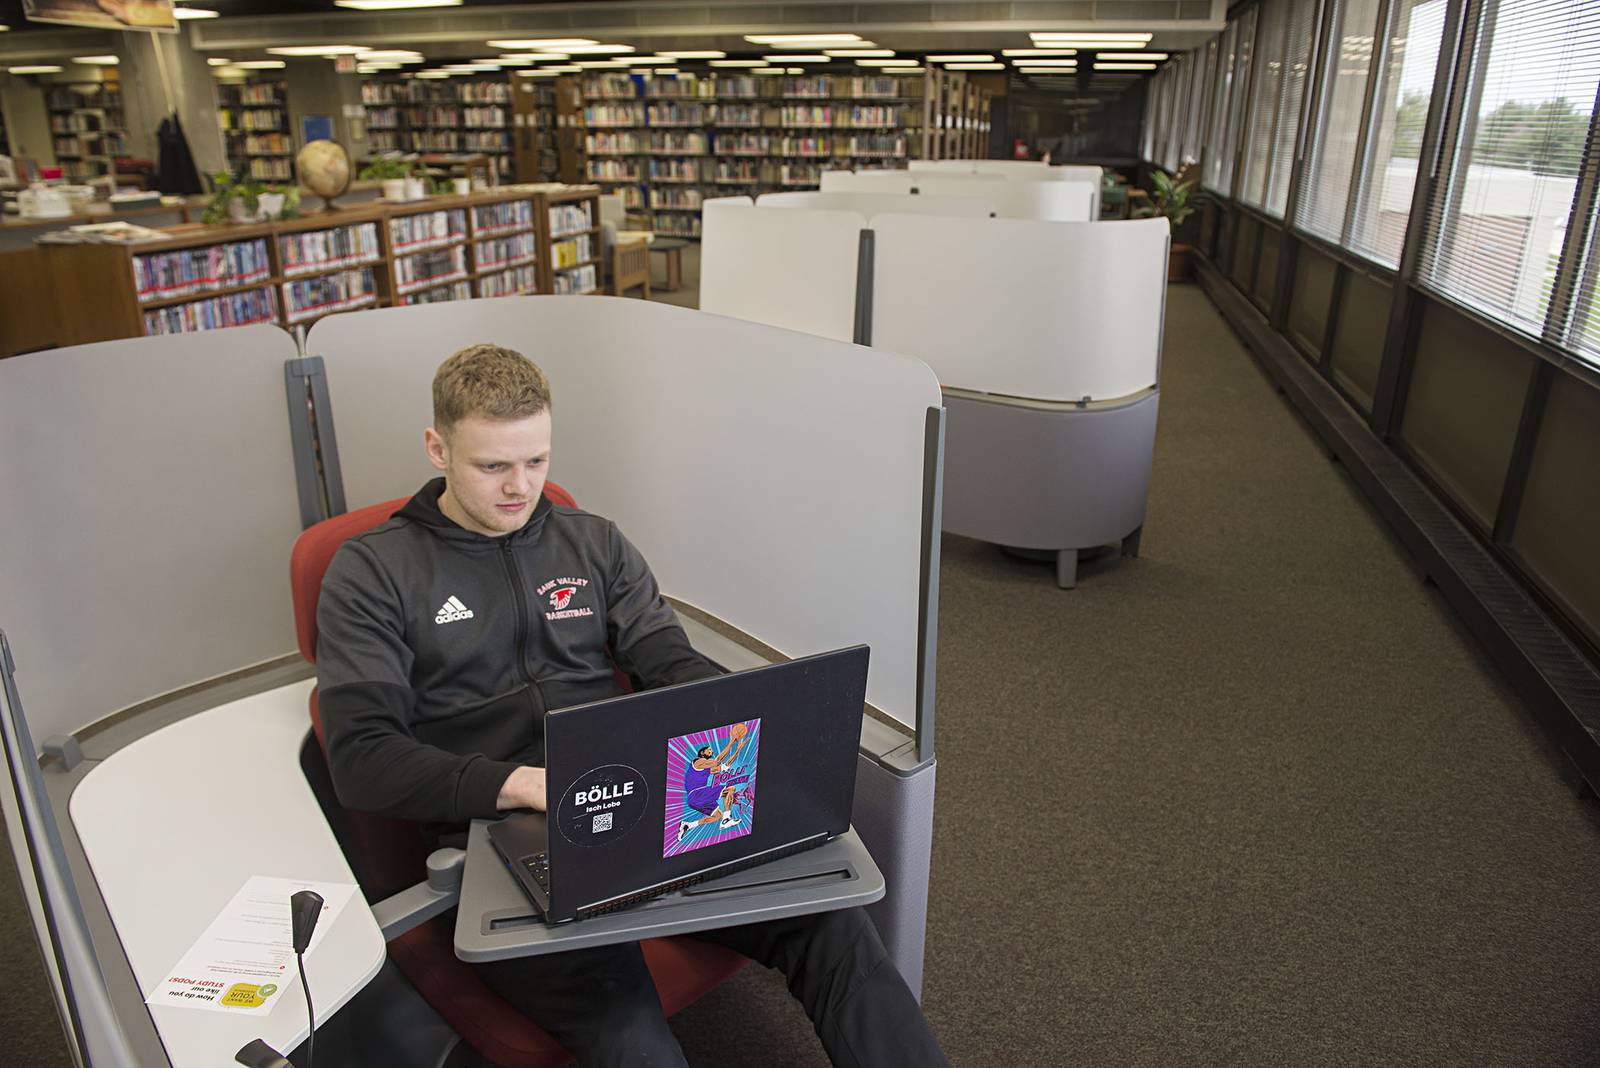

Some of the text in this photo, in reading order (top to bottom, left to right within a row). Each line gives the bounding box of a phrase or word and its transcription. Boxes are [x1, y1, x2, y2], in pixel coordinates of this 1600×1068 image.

[556, 577, 588, 587] VALLEY
[435, 609, 474, 625] adidas
[545, 607, 594, 620] BASKETBALL
[574, 781, 634, 806] BÖLLE
[168, 976, 225, 988] STUDY PODS?
[206, 987, 220, 995] like
[230, 992, 256, 1000] YOUR
[196, 993, 215, 1001] How
